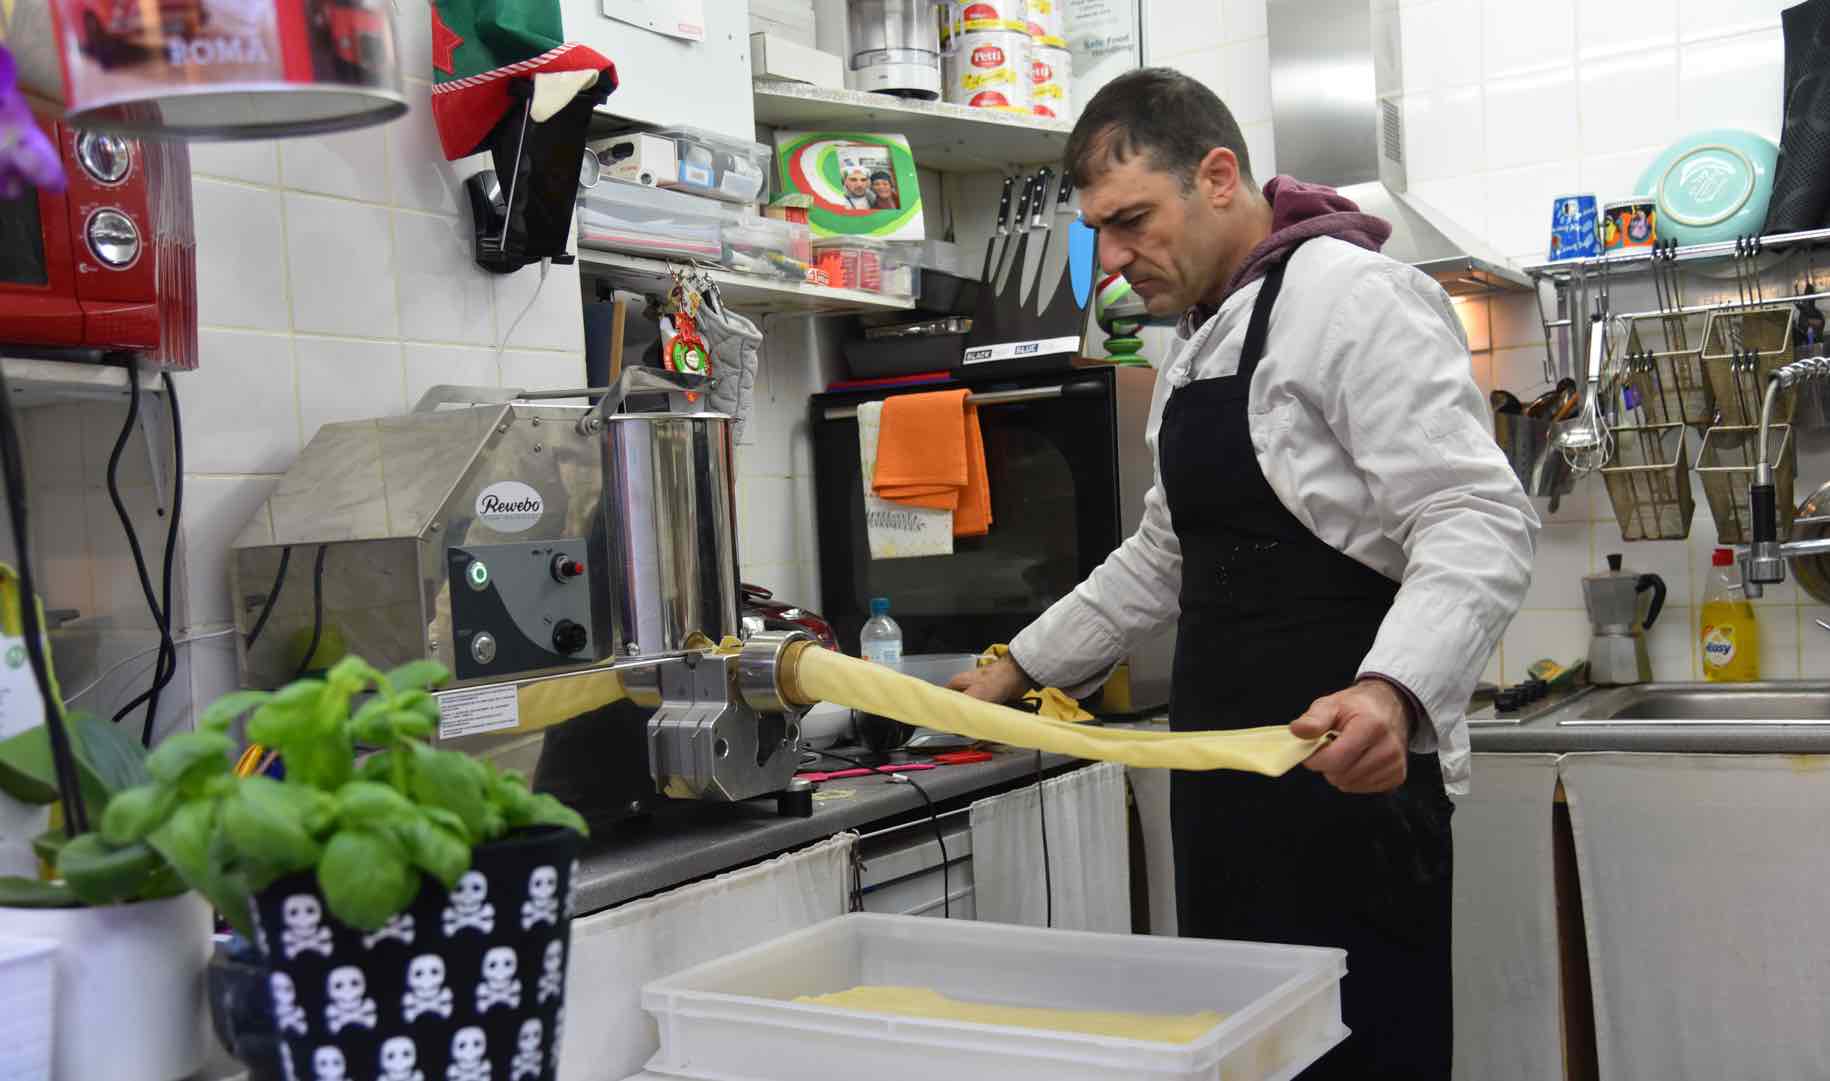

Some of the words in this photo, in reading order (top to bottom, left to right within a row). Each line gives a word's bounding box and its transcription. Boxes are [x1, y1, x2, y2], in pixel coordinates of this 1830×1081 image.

[167, 36, 272, 65] ROMA
[966, 350, 992, 361] BLACK
[1015, 345, 1038, 355] BLUE
[480, 494, 540, 514] Rewebo
